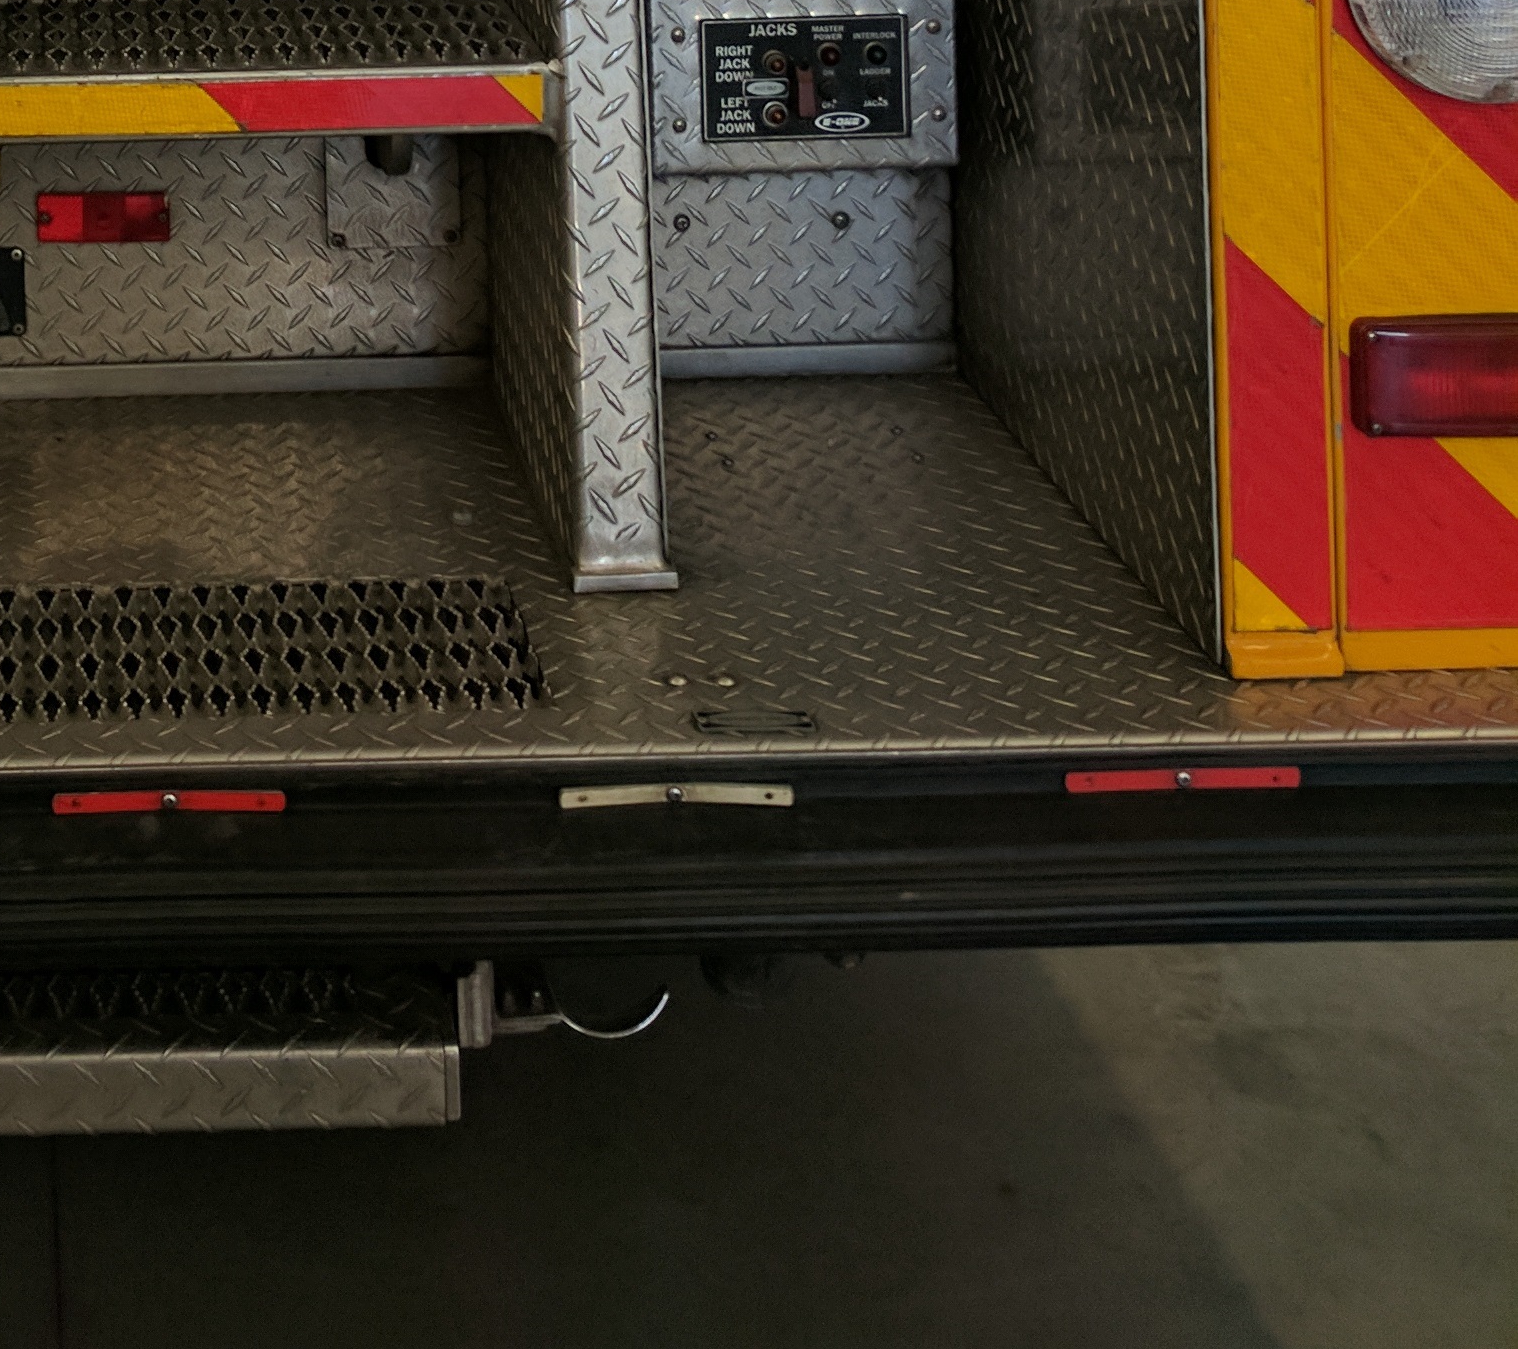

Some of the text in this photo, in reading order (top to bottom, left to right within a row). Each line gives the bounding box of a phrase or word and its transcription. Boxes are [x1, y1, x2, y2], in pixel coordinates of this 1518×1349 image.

[749, 23, 797, 37] JACKS
[852, 32, 897, 40] INTERLOCK
[814, 33, 843, 41] POWER
[715, 45, 754, 57] RIGHT
[719, 58, 750, 70] JACK
[715, 71, 754, 83] DOWN
[721, 97, 749, 108] LEFT
[720, 110, 751, 121] JACK
[716, 122, 756, 134] DOWN
